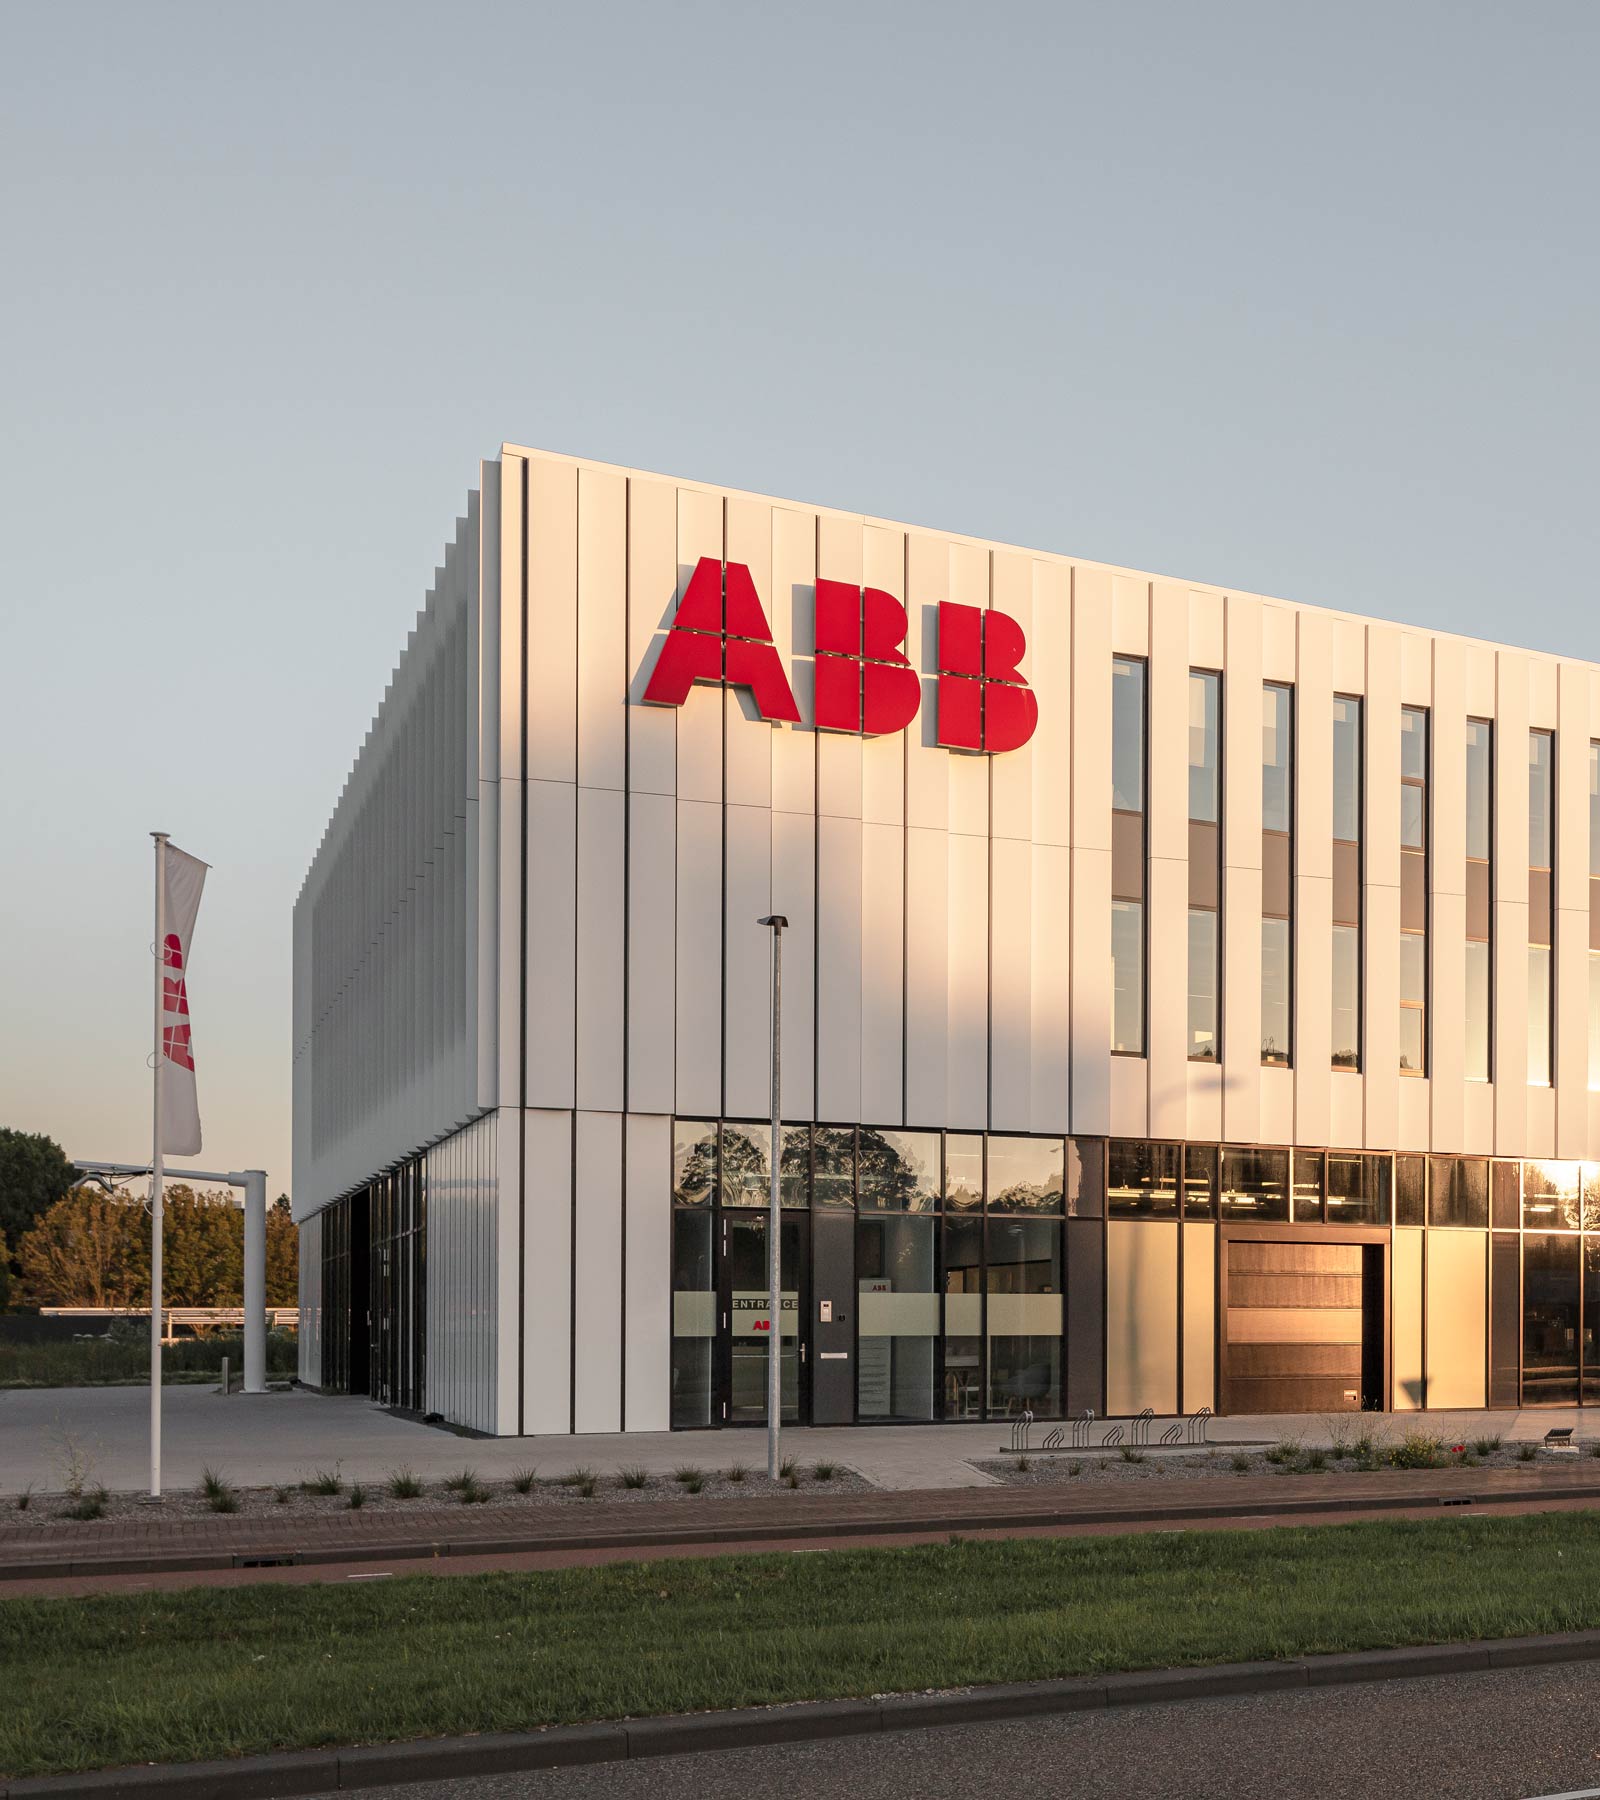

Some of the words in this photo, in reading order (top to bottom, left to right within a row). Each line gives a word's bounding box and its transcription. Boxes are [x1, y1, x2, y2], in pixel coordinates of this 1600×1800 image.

[641, 556, 1039, 754] ABB
[732, 1300, 799, 1309] ENTRACE
[752, 1320, 770, 1331] AB
